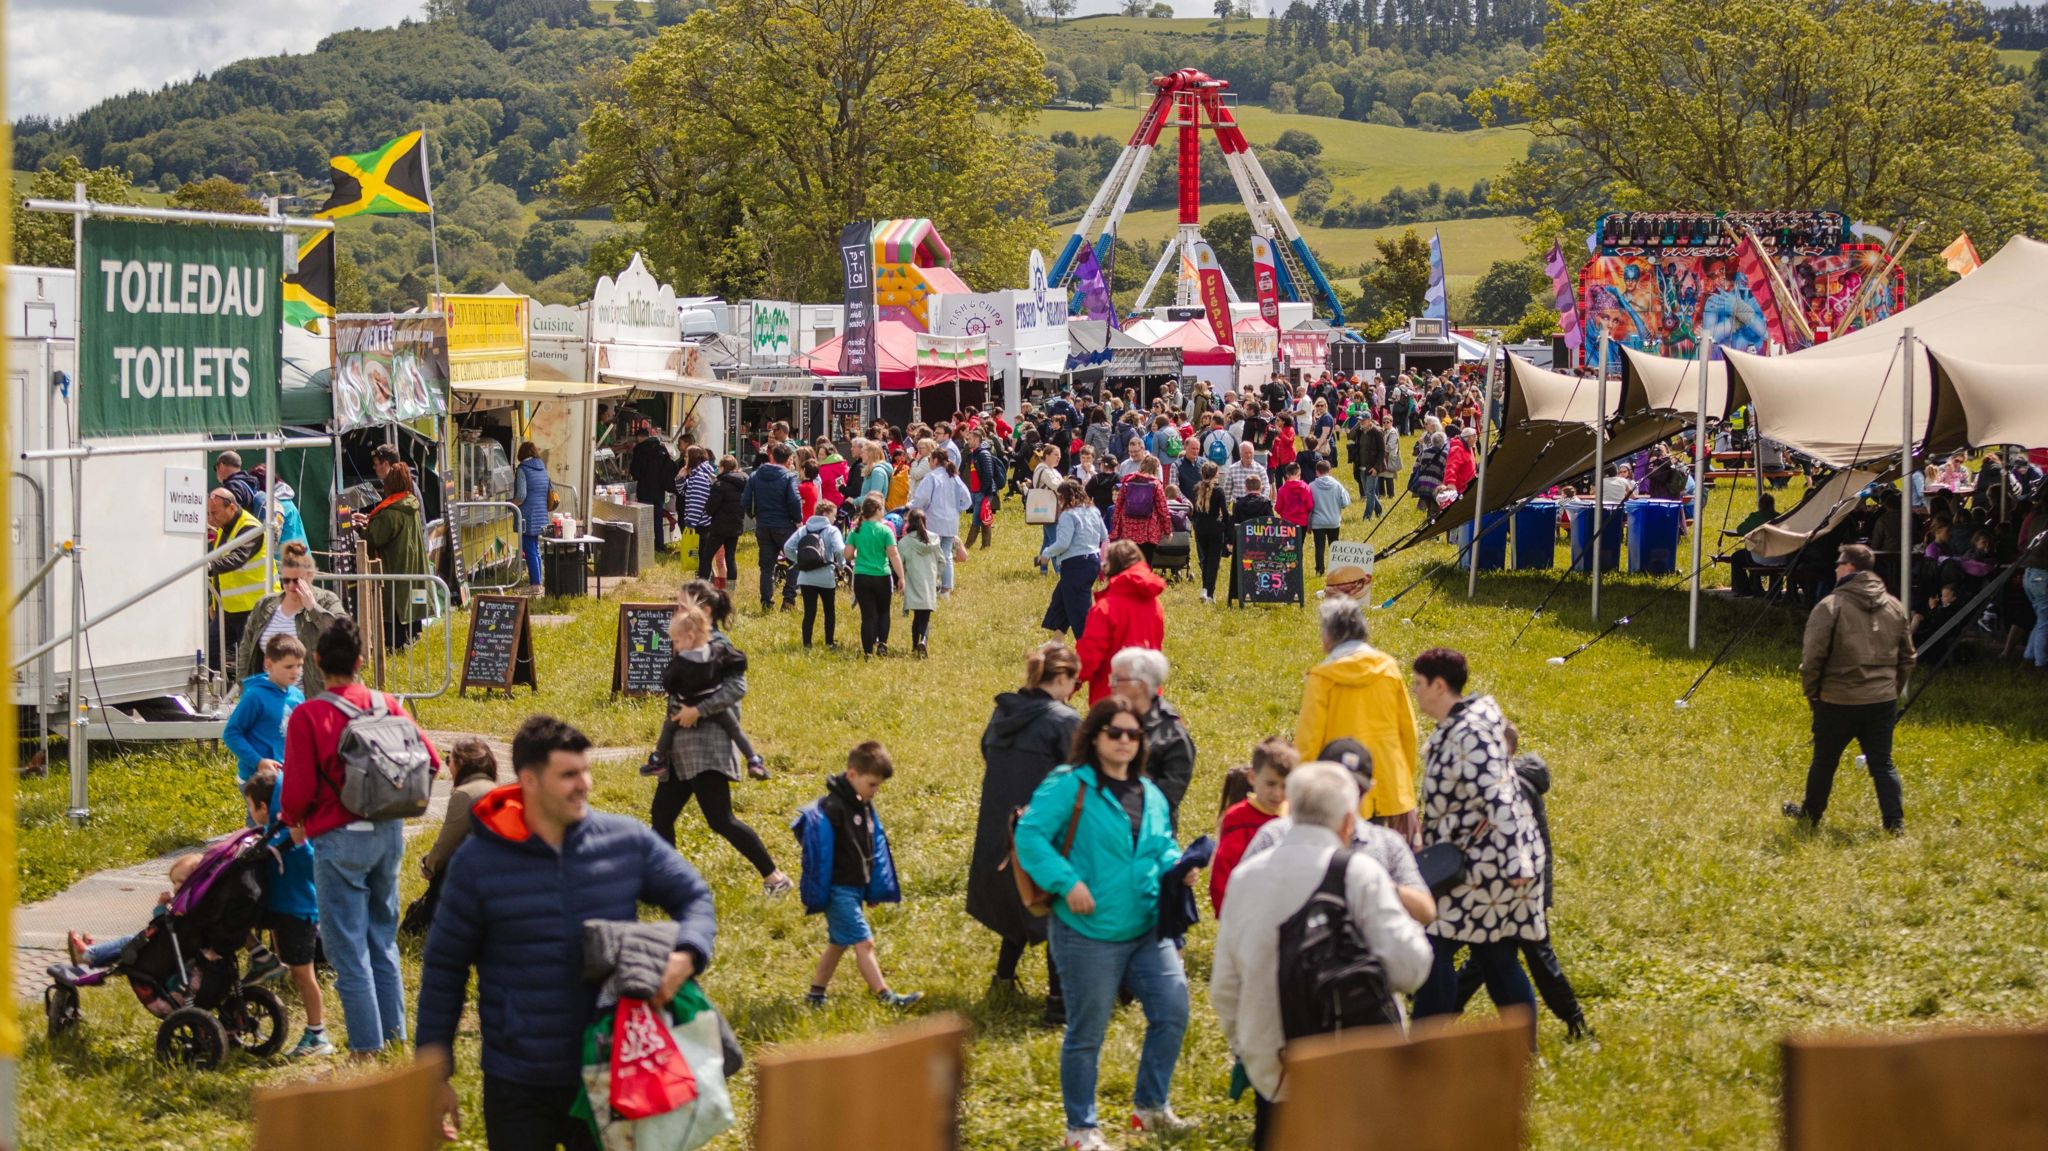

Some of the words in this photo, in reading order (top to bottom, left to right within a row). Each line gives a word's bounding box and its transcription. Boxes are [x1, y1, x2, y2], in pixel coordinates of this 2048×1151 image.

[101, 260, 264, 317] TOILEDAU
[950, 303, 968, 326] FISH
[979, 301, 1003, 326] CHIPS
[533, 317, 574, 332] Cuisine
[531, 350, 568, 361] Catering
[113, 346, 250, 399] TOILETS
[169, 491, 203, 505] Wrinalau
[173, 510, 199, 524] Urinals
[1246, 525, 1296, 537] BWYDLEN
[1331, 544, 1364, 555] BACON
[1332, 555, 1351, 563] EGG
[1353, 556, 1373, 565] BAP
[1260, 573, 1282, 589] £5
